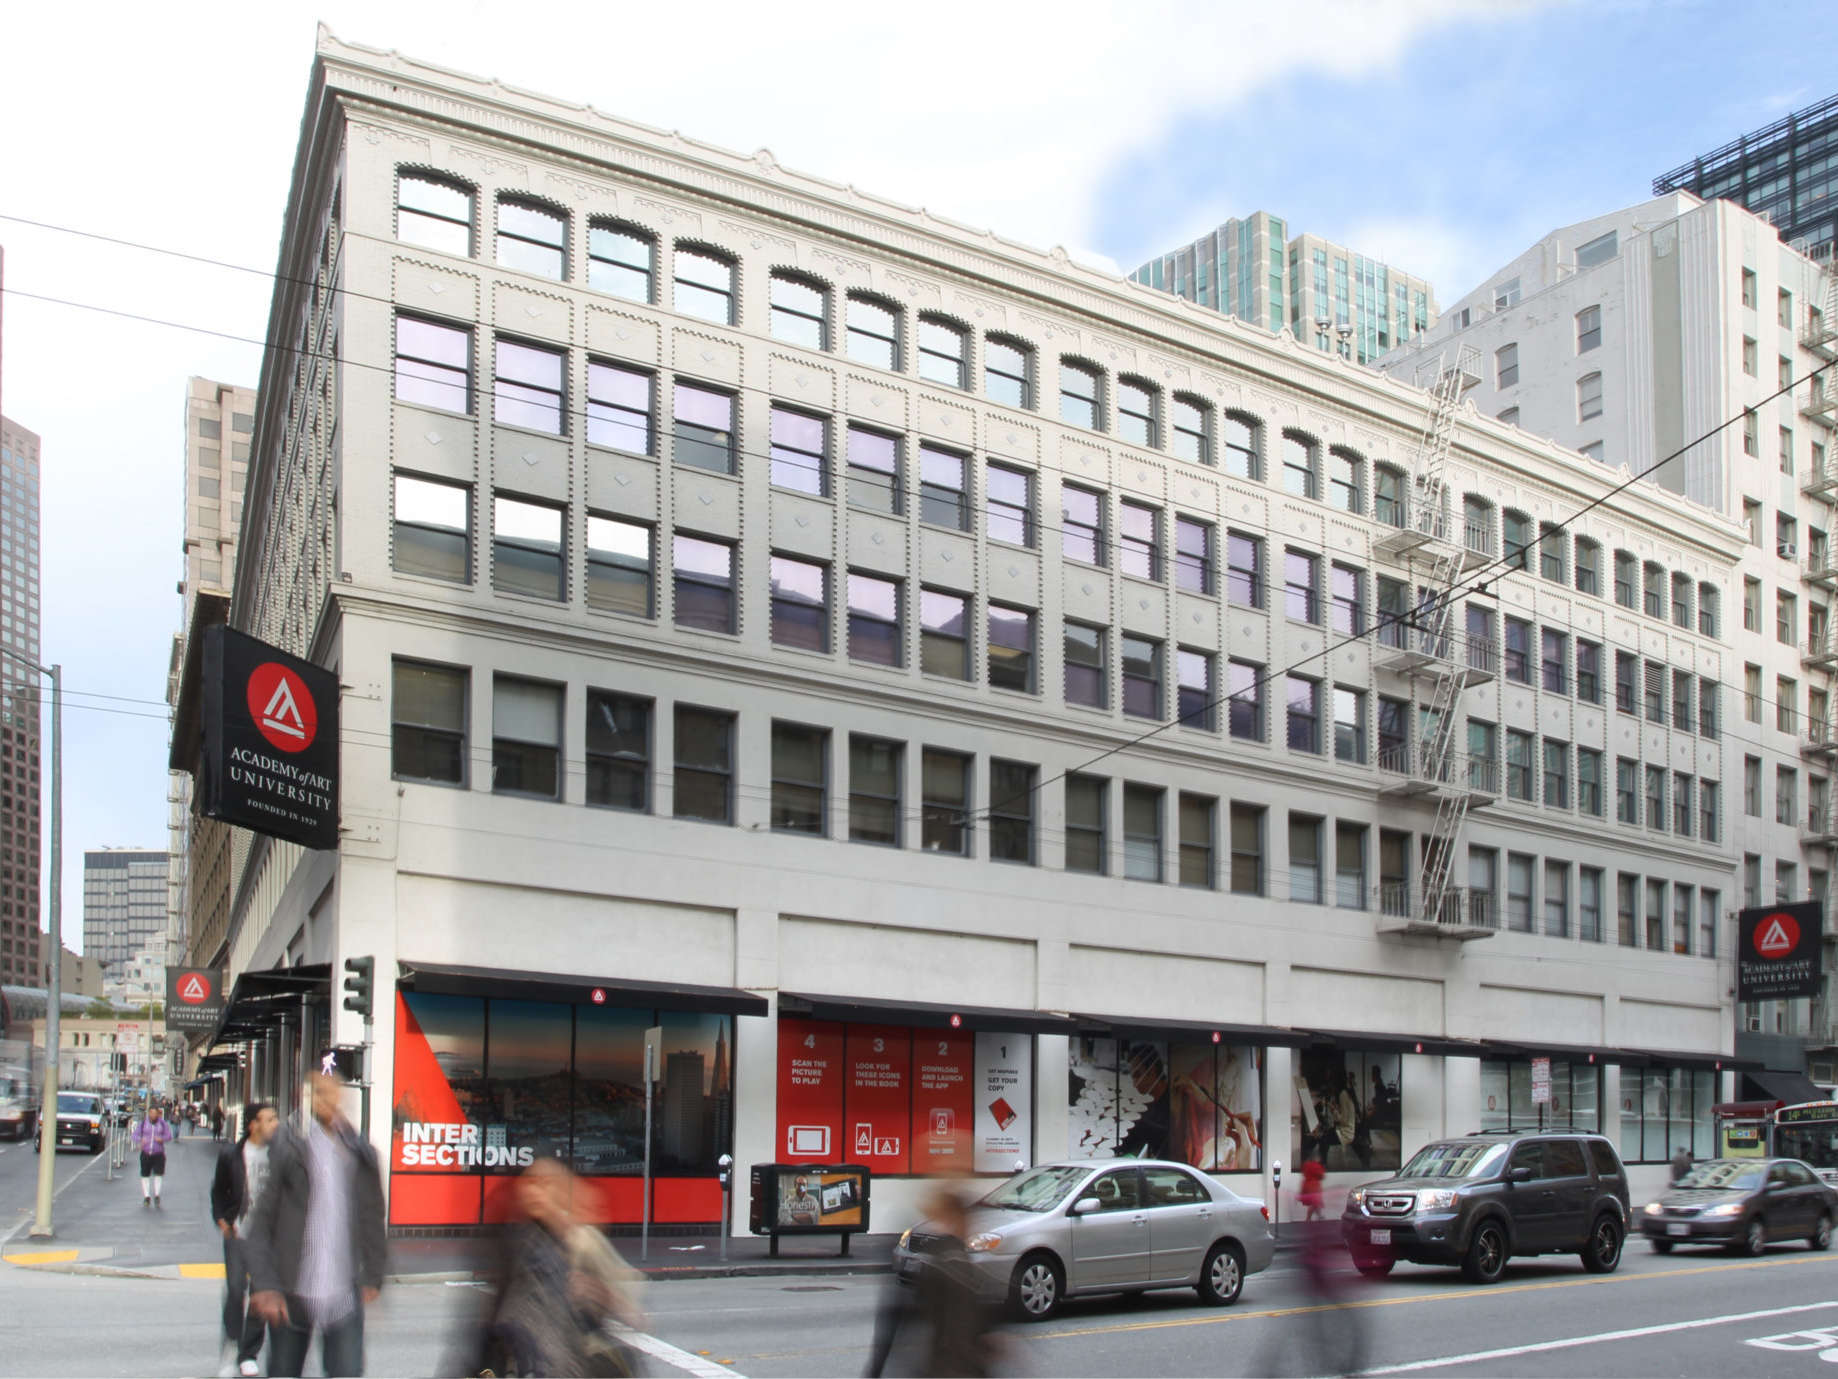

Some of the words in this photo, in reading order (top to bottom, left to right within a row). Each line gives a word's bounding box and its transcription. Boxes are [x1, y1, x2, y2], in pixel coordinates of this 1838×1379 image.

[231, 746, 299, 780] ACADEMY
[298, 771, 310, 786] of
[309, 774, 332, 791] ART
[231, 766, 332, 811] UNIVERSITY
[247, 798, 287, 817] FOUNDED
[289, 811, 299, 820] IN
[301, 815, 317, 826] 1929
[1742, 970, 1809, 985] UNIVERSITY
[169, 1012, 219, 1021] UNIVERSITY
[804, 1034, 815, 1049] 4
[873, 1038, 885, 1052] 3
[938, 1041, 948, 1055] 2
[1000, 1046, 1007, 1059] 1
[791, 1059, 812, 1067] SCAN
[921, 1065, 959, 1073] DOWNLOAD
[791, 1068, 822, 1076] PICTURE
[802, 1077, 821, 1085] PLAY
[855, 1079, 863, 1087] IN
[403, 1121, 478, 1143] INTER
[401, 1144, 534, 1166] SECTIONS
